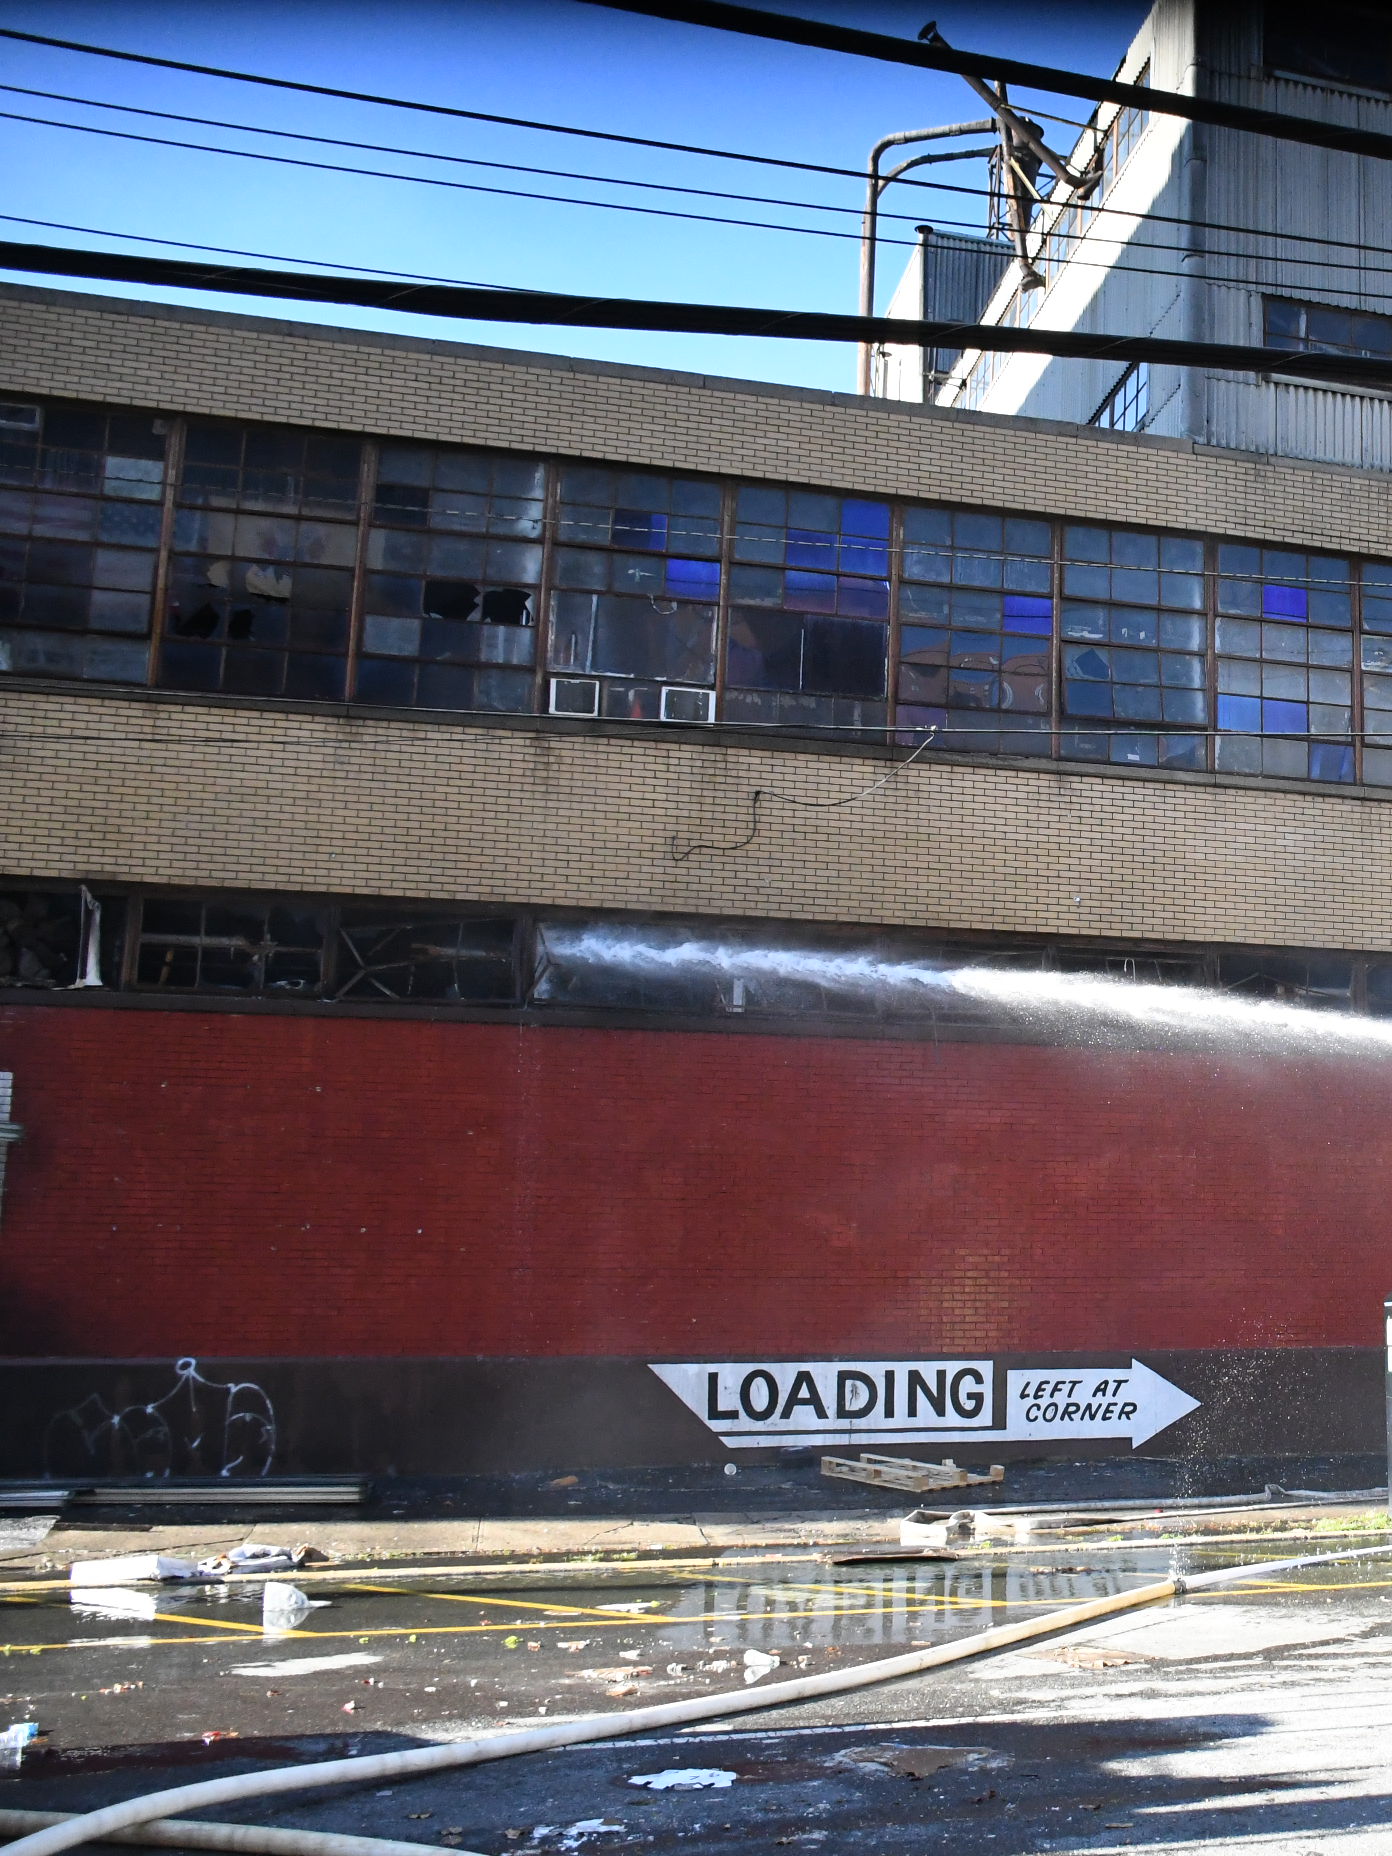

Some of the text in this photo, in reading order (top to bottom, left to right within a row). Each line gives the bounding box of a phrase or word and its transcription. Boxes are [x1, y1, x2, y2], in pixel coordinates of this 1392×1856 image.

[707, 1367, 985, 1421] LOADING
[1019, 1379, 1129, 1400] LEFT AT
[1025, 1402, 1138, 1422] CORNER
